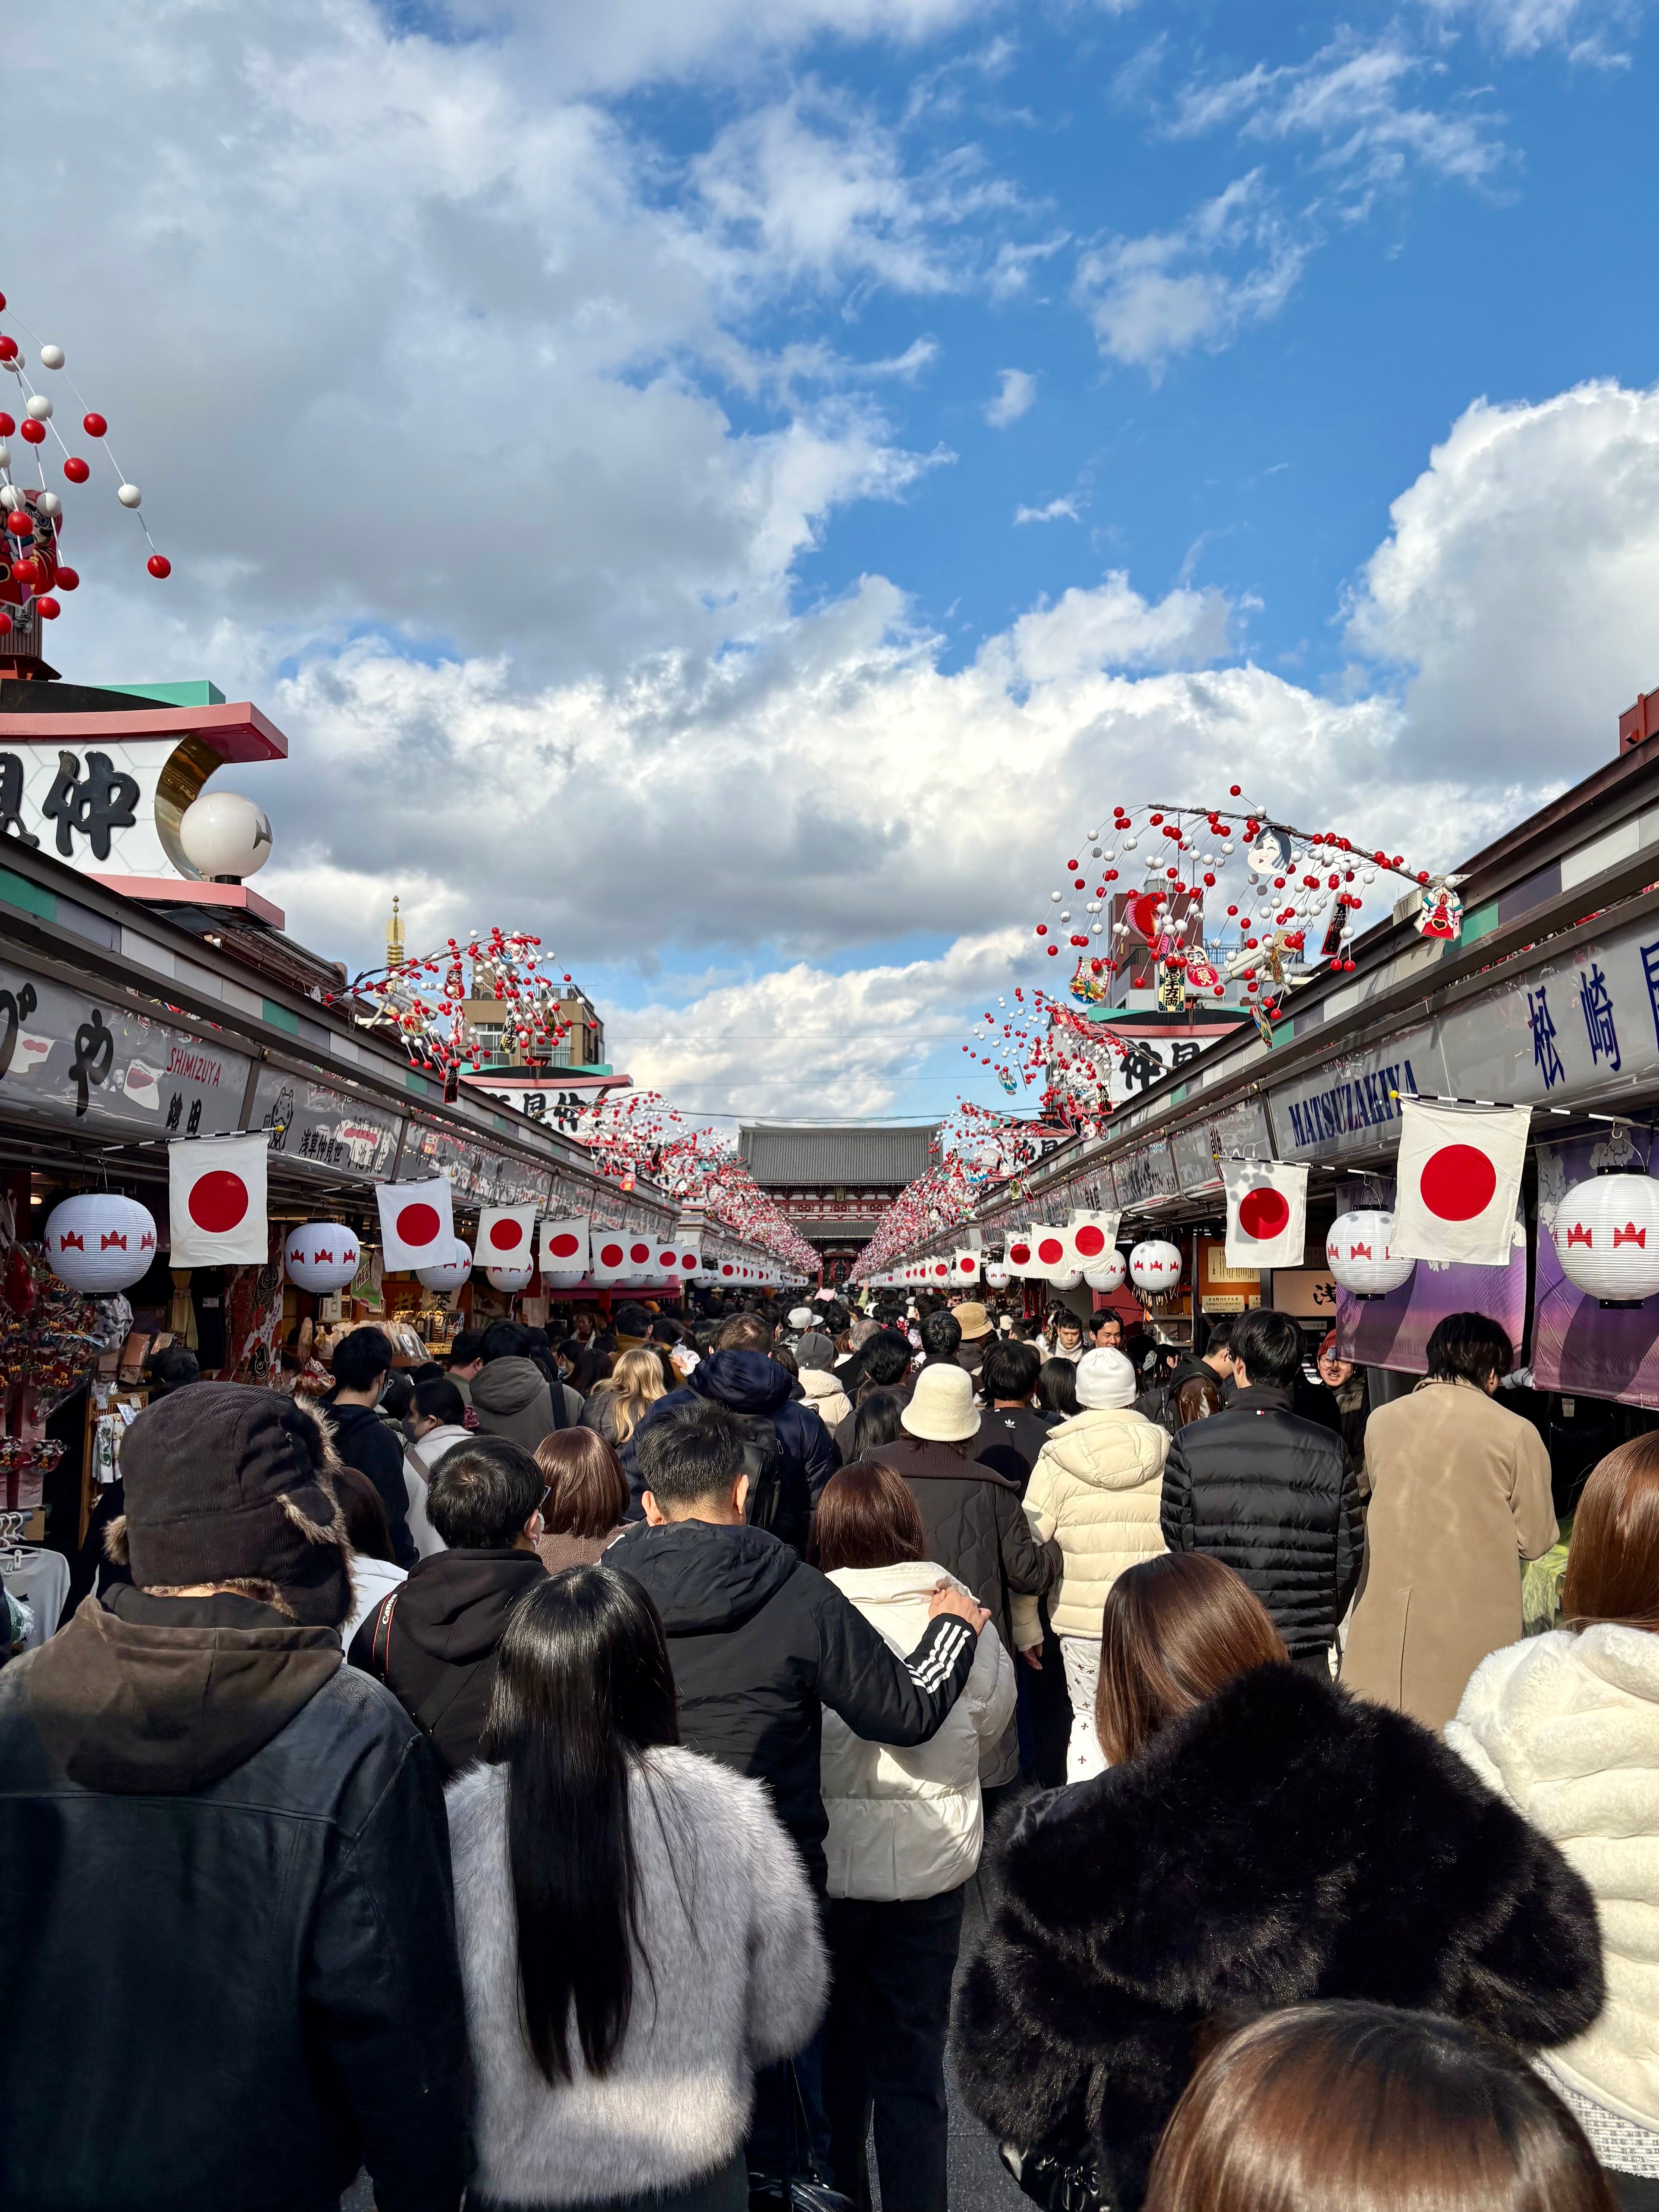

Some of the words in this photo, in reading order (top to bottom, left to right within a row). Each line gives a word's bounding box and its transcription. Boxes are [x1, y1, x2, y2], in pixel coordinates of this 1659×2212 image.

[166, 1047, 221, 1087] SHIMIZUYA
[1288, 1060, 1420, 1147] MATSUZAKIYA
[298, 1128, 343, 1163] 浅草仲見世
[382, 1594, 398, 1625] Canon
